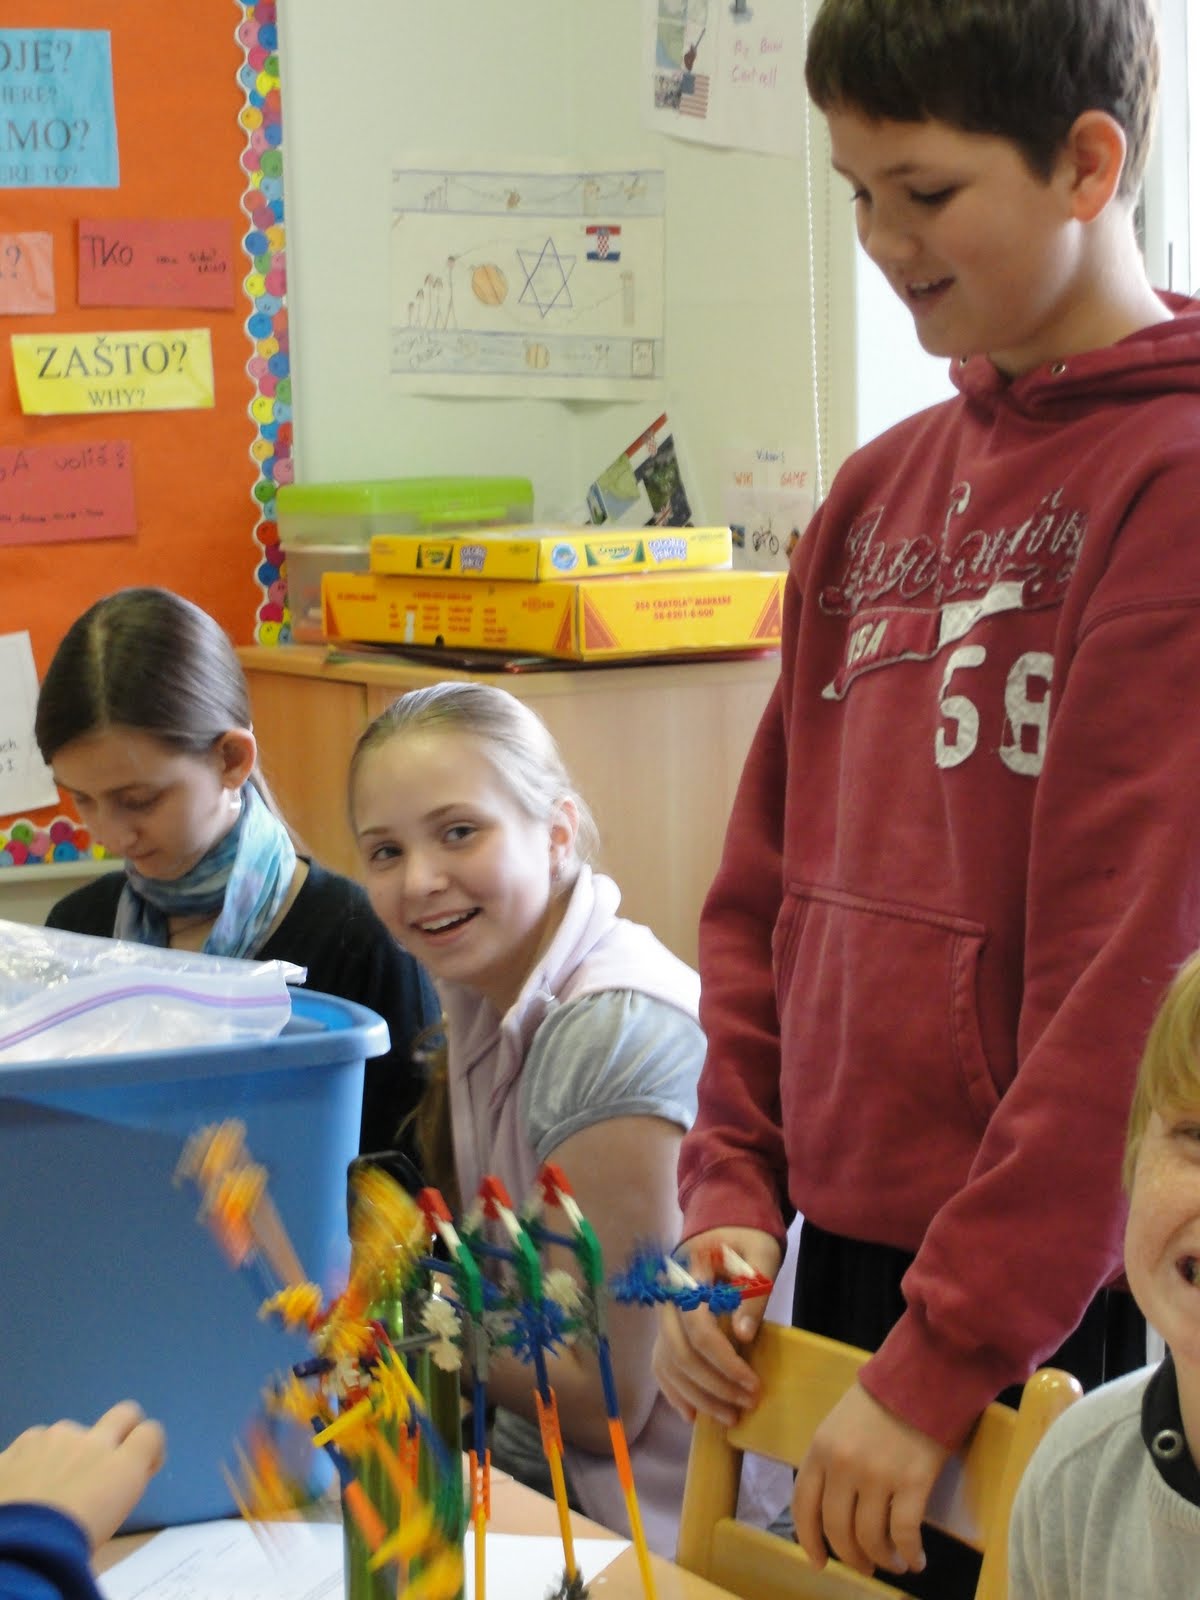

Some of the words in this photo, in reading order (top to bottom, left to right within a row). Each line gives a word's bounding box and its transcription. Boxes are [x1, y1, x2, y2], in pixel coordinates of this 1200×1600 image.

[0, 119, 90, 152] MO?
[37, 337, 189, 381] ZAŠTO?
[88, 388, 146, 408] WHY?
